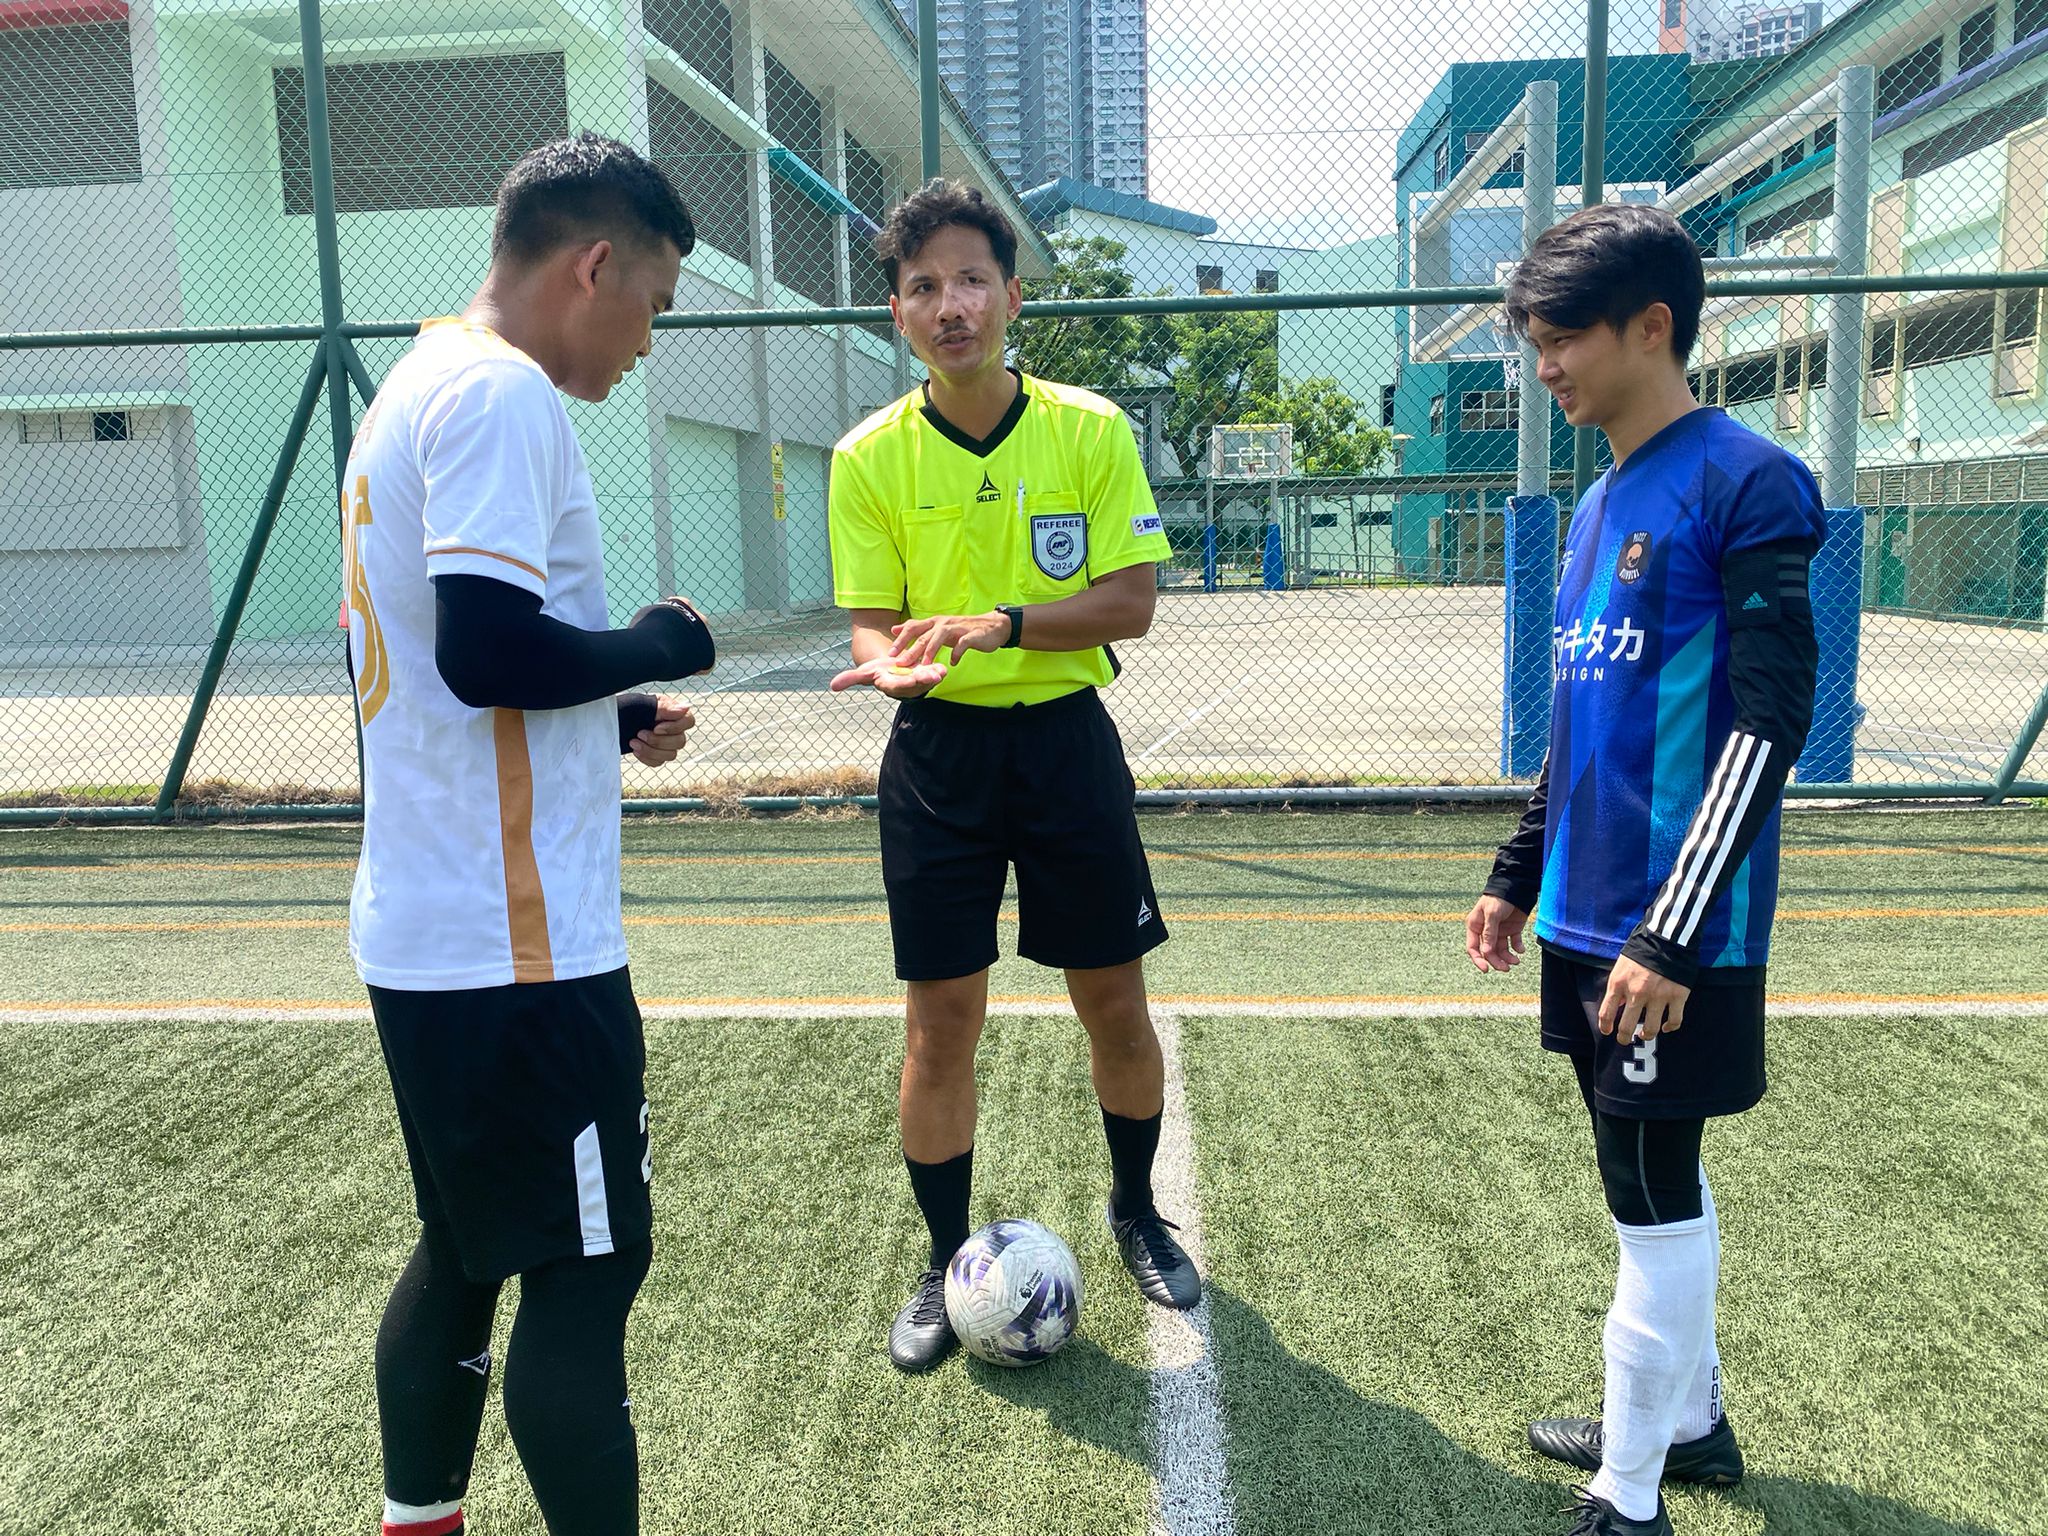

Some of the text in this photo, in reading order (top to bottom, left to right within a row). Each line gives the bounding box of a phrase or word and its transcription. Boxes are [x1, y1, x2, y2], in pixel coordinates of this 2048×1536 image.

[975, 493, 1001, 503] SELECT
[1036, 520, 1081, 529] REFEREE
[1050, 562, 1073, 570] 2024
[1557, 667, 1604, 681] ESIGN
[1623, 1023, 1657, 1084] 3
